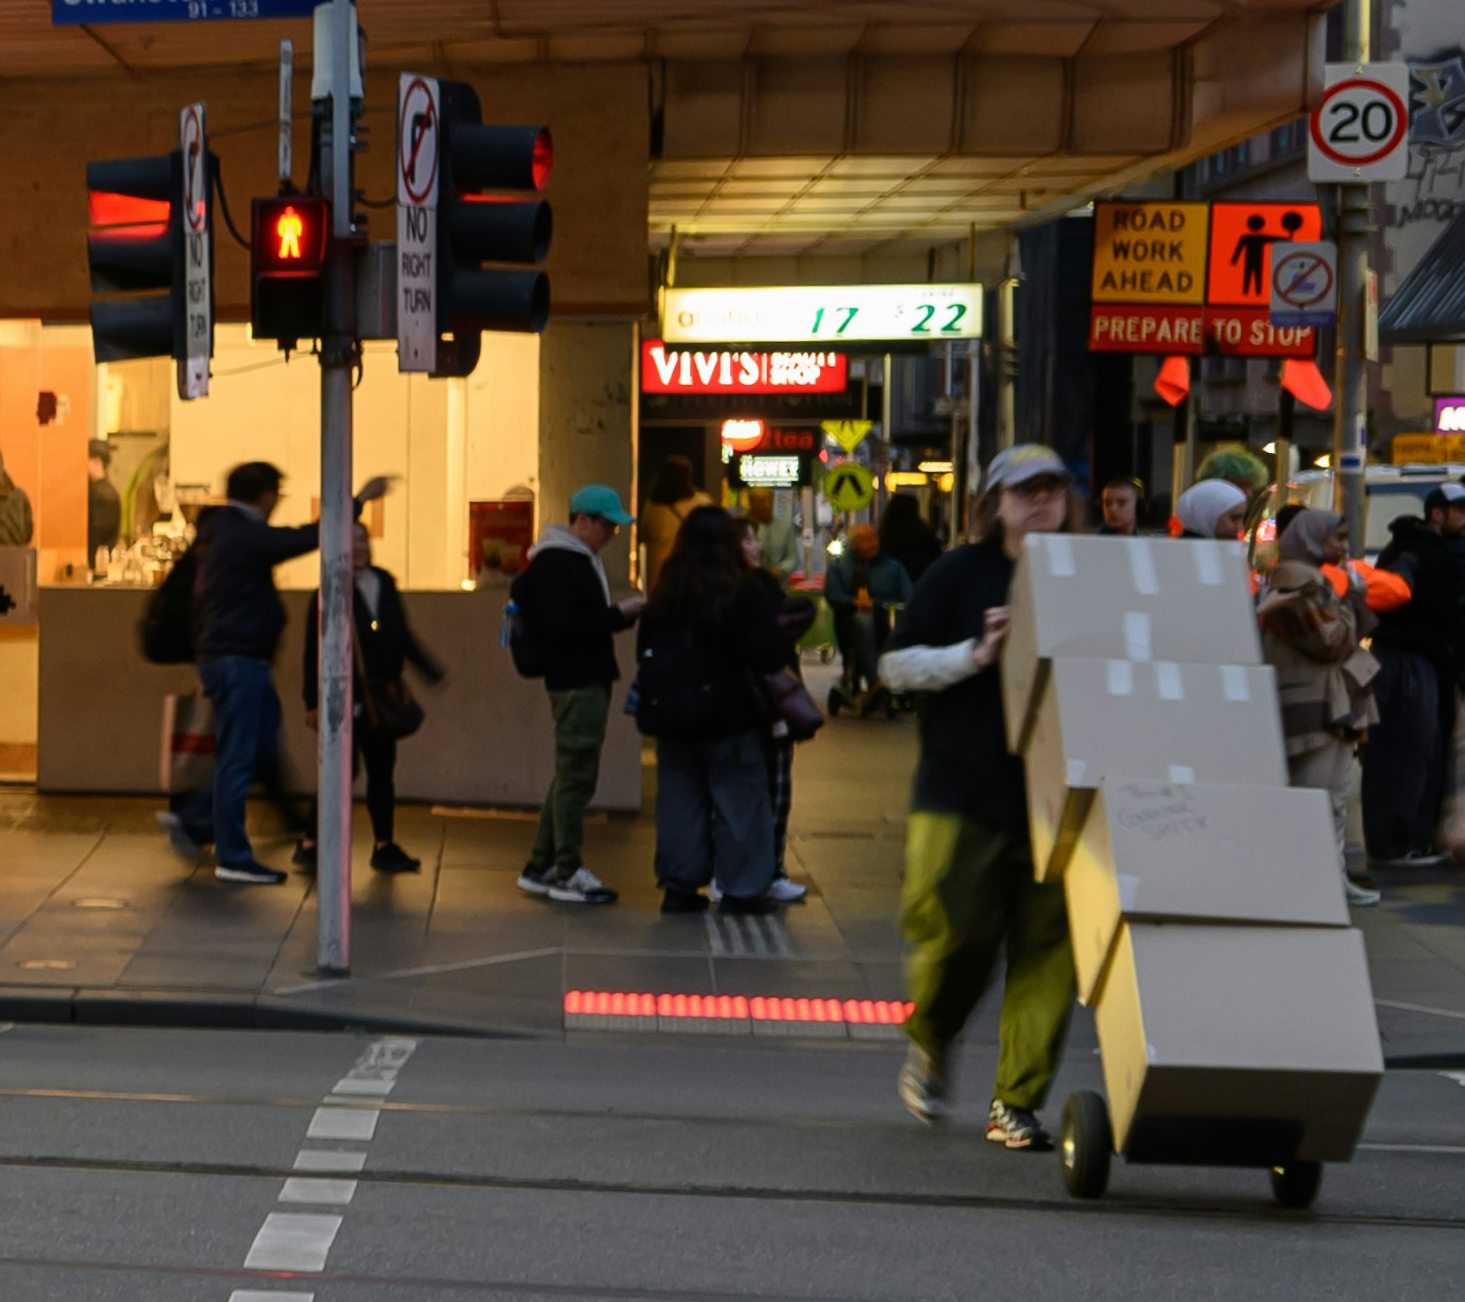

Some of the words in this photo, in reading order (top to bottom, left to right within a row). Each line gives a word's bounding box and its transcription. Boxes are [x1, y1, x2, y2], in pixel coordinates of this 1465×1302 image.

[188, 2, 208, 18] 91
[230, 1, 259, 17] 133
[1328, 99, 1393, 143] 20
[406, 207, 428, 244] NO
[1113, 209, 1185, 232] ROAD
[188, 232, 204, 267] NO
[1113, 240, 1184, 262] WORK
[402, 253, 432, 280] RIGHT
[1100, 270, 1194, 293] AHEAD
[403, 288, 432, 314] TURN
[811, 306, 860, 334] 17
[910, 303, 968, 333] 22
[1094, 314, 1203, 345] PREPARE
[1213, 318, 1242, 345] TO
[1249, 319, 1311, 347] STOP
[650, 347, 760, 387] VIVI'S
